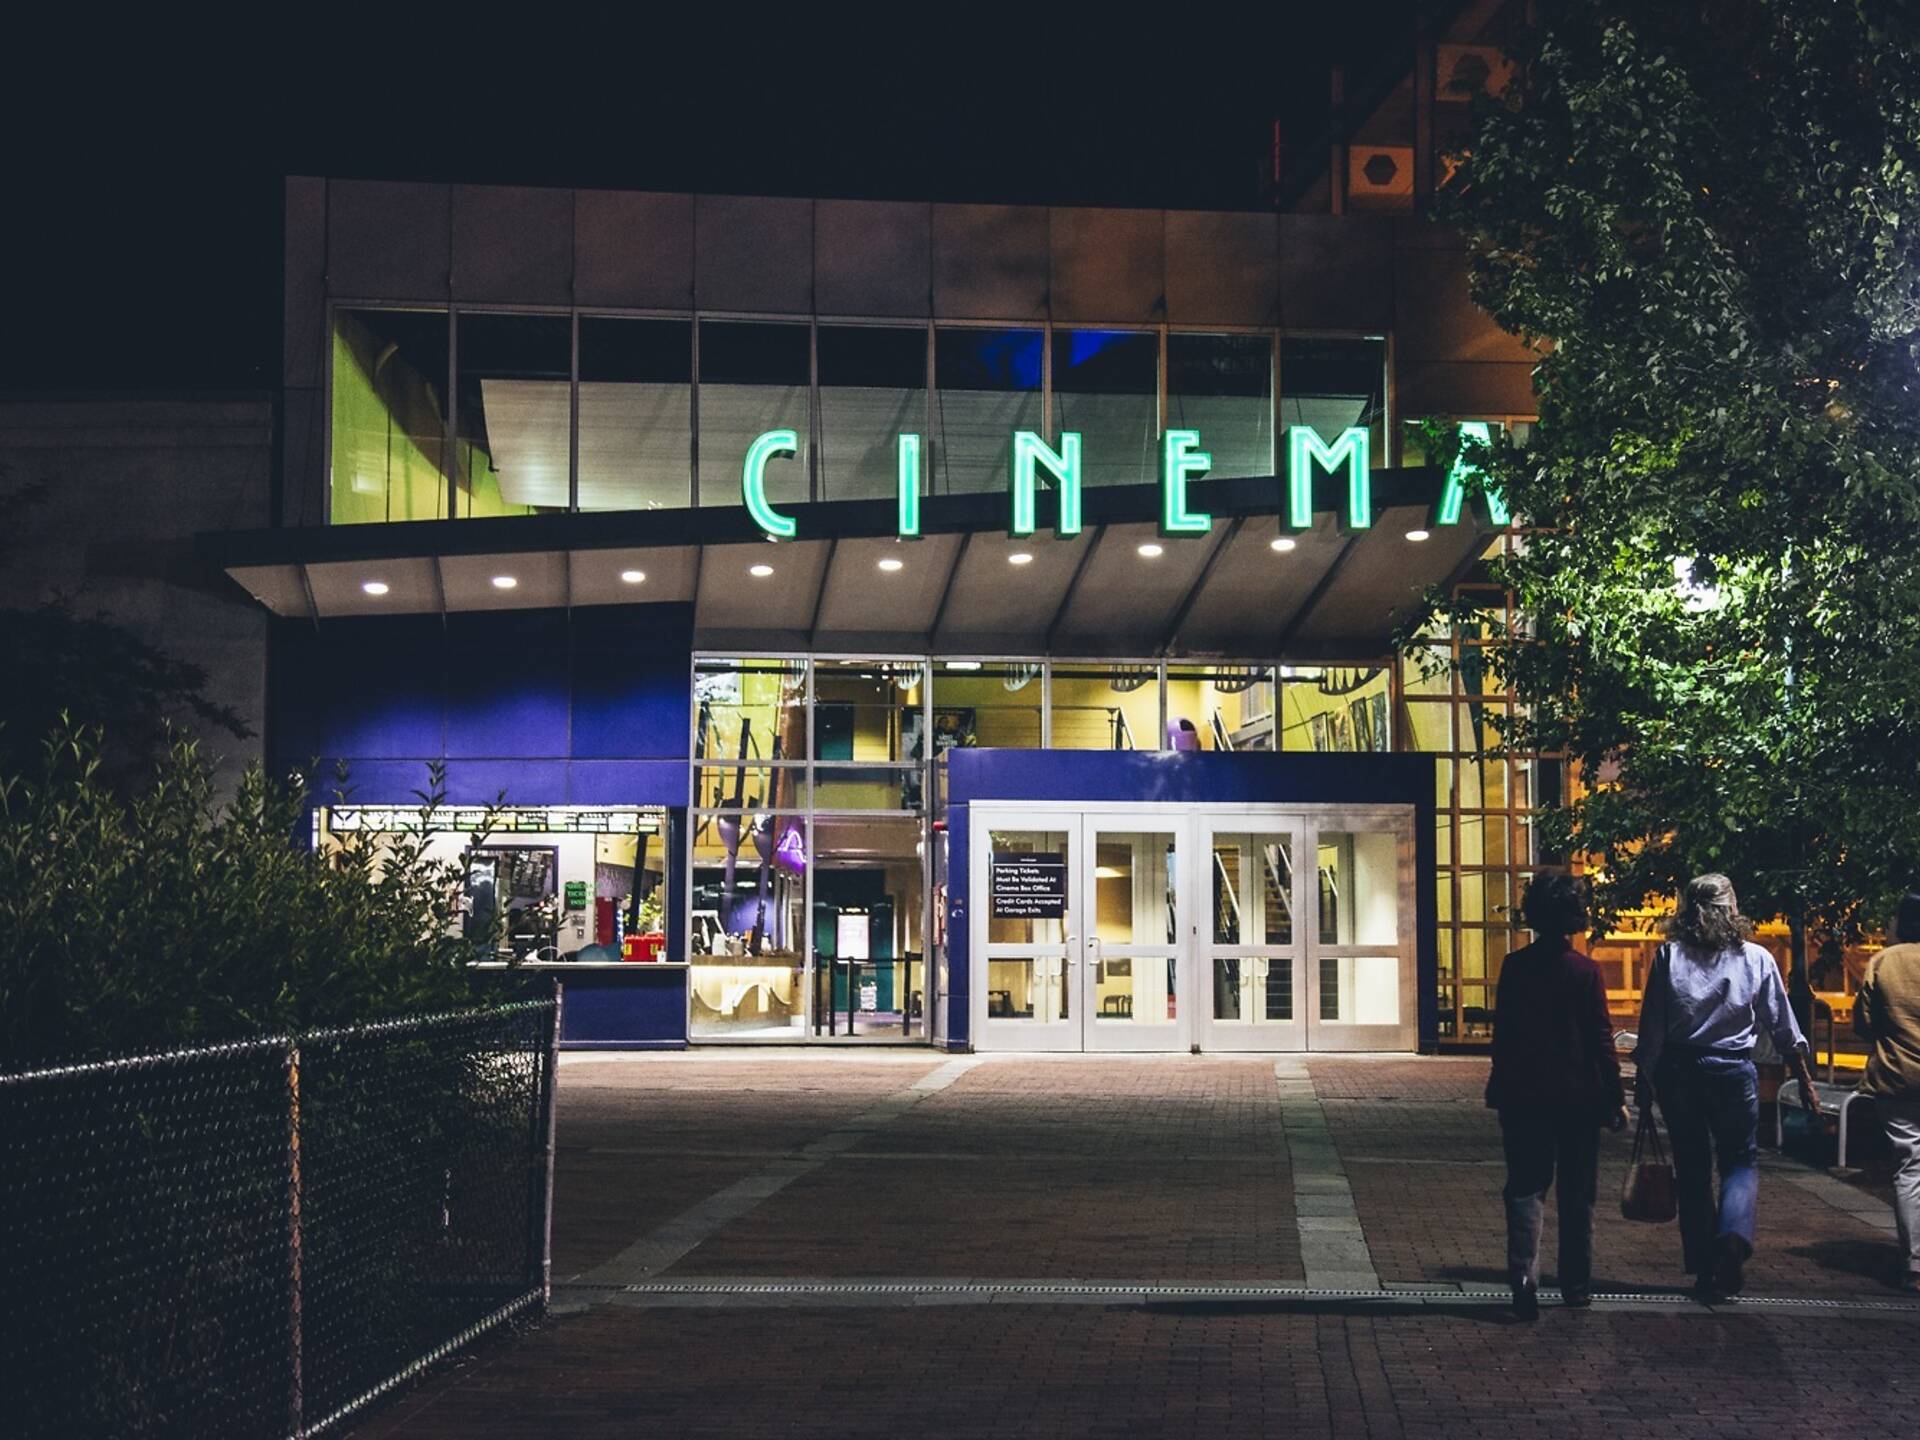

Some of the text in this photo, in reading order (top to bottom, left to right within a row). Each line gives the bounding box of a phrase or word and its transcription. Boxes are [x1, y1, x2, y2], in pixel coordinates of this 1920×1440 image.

[743, 421, 1511, 538] CINEMA
[996, 867, 1018, 875] Parking
[1004, 906, 1026, 914] Garage
